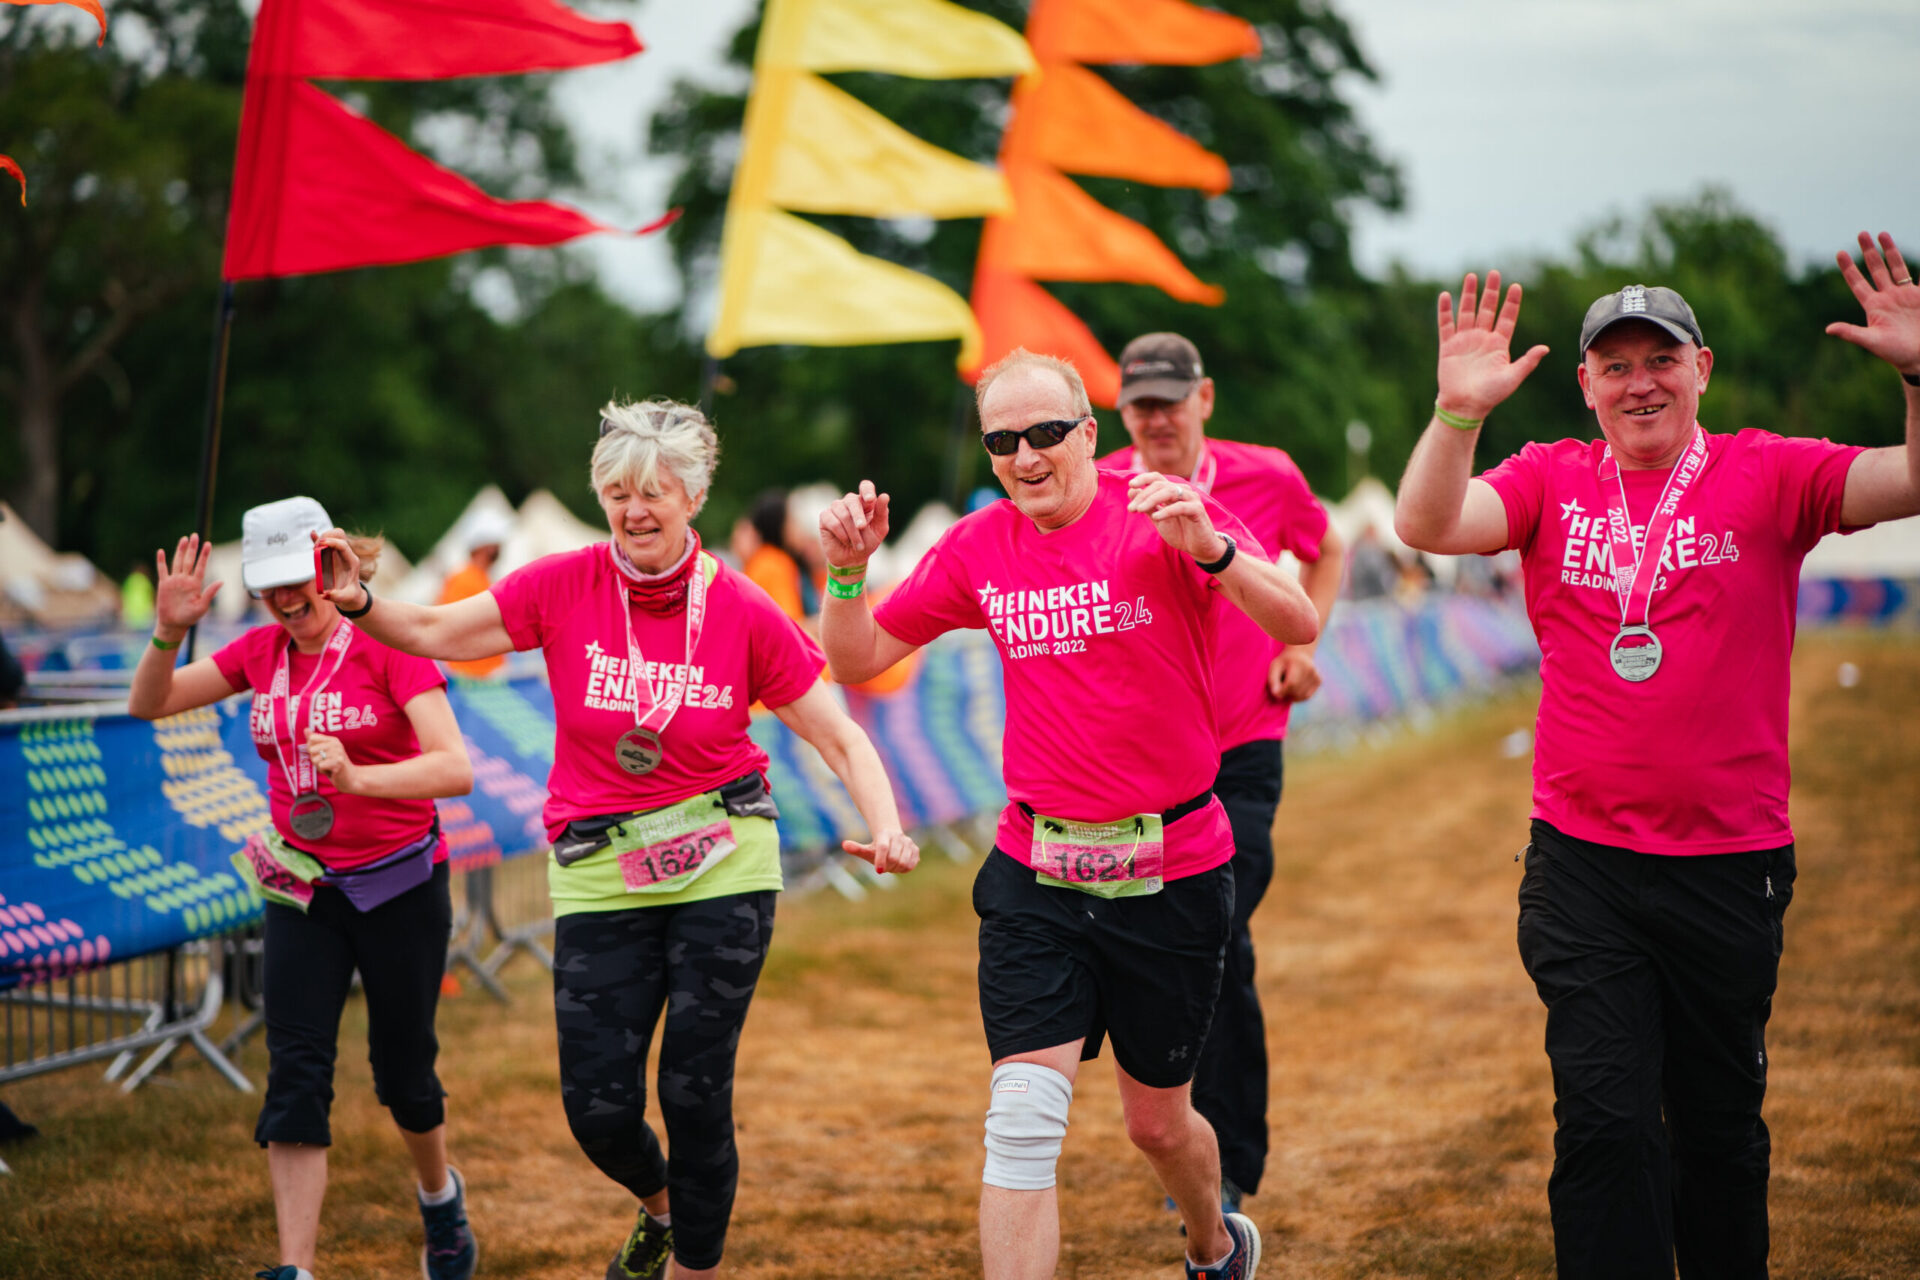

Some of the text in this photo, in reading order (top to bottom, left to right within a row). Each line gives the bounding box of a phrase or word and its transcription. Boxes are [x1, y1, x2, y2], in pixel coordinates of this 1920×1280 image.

[1676, 452, 1701, 488] RELAY
[1660, 487, 1685, 516] RACE
[1607, 507, 1628, 544] 2022
[989, 580, 1110, 616] HEINEKEN
[1561, 569, 1617, 592] READIN
[1008, 639, 1087, 660] ADING 2022
[251, 846, 297, 895] 1622
[641, 836, 716, 881] 1620
[1055, 852, 1135, 881] 1621
